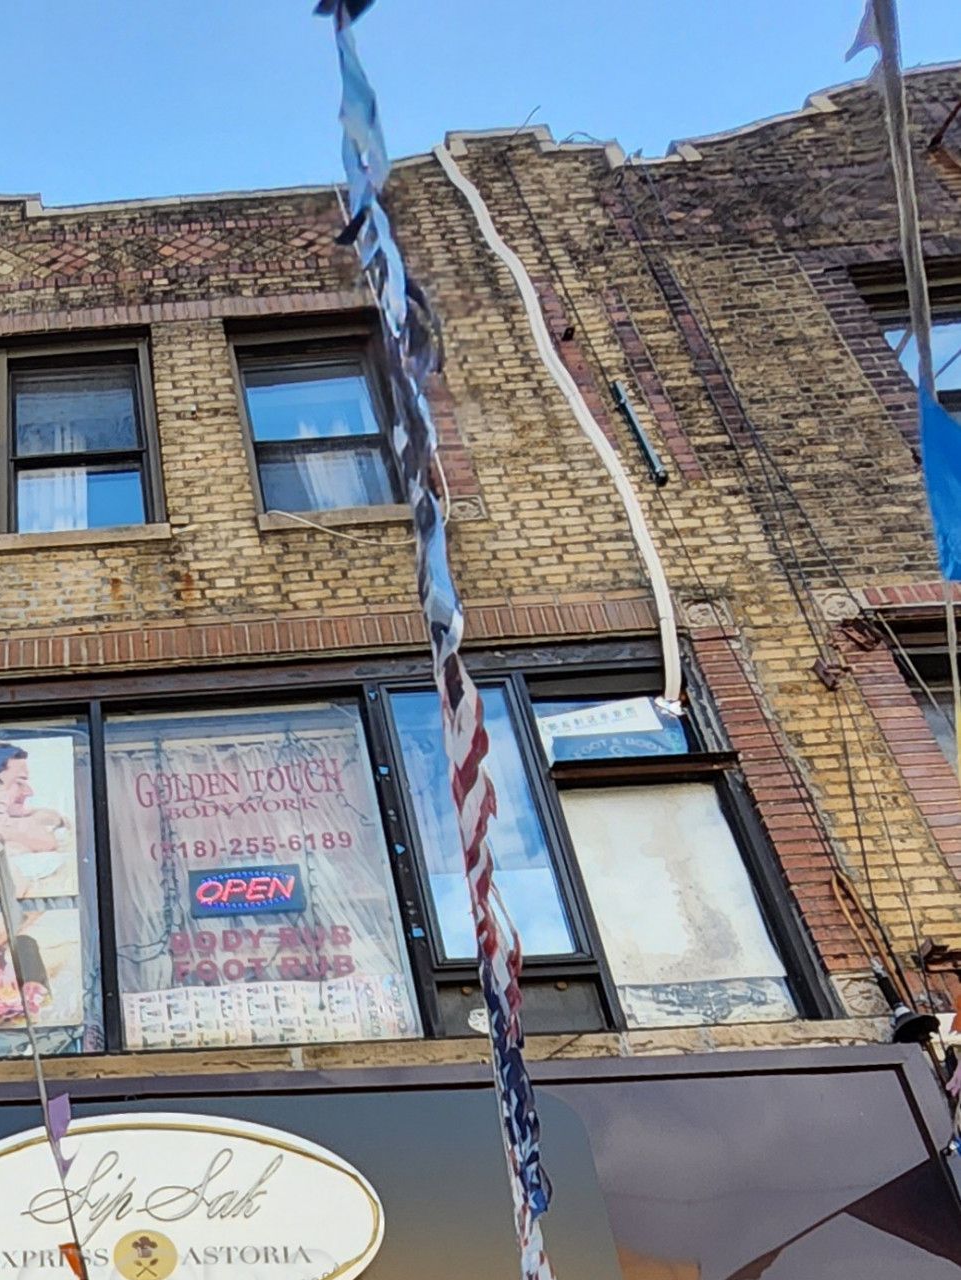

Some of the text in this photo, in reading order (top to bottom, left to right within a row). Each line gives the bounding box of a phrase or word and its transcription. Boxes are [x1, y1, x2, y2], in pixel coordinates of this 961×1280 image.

[136, 758, 344, 808] GOLDEN TOUCH
[166, 797, 318, 821] BODYWORK
[196, 876, 294, 905] OPEN
[170, 925, 352, 954] BODY RUB
[174, 954, 356, 981] FOOT RUB
[136, 1147, 285, 1222] Sak
[182, 1245, 312, 1266] ASTORIA
